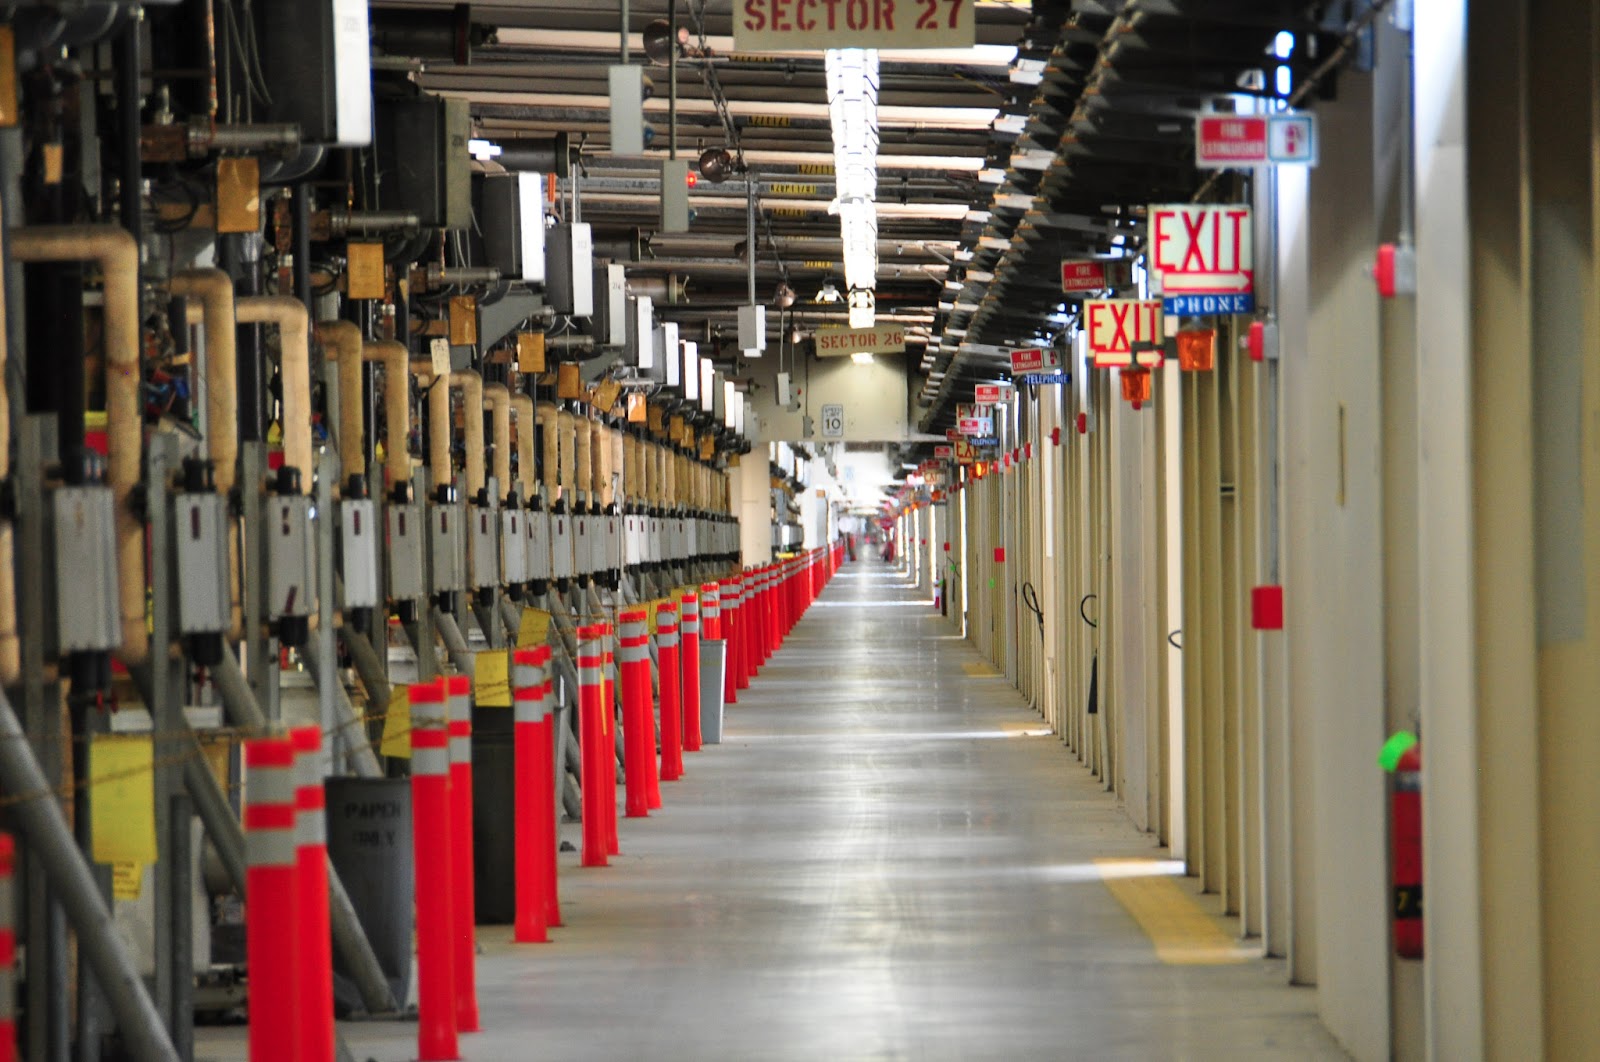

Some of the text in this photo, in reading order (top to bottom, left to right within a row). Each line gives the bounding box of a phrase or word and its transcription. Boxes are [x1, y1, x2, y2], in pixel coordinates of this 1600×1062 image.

[744, 0, 962, 32] SECTOR 27
[1154, 211, 1247, 272] EXIT
[1076, 265, 1092, 276] FIRE
[1064, 276, 1104, 288] EXTINGUISHER
[1173, 296, 1245, 314] PHONE
[1089, 303, 1161, 350] EXIT
[821, 331, 902, 349] SECTOR 26
[1020, 352, 1032, 361] FIRE
[1013, 359, 1041, 370] EXTINGUISHER
[1026, 374, 1068, 384] TELEPHONE
[825, 417, 841, 430] 10
